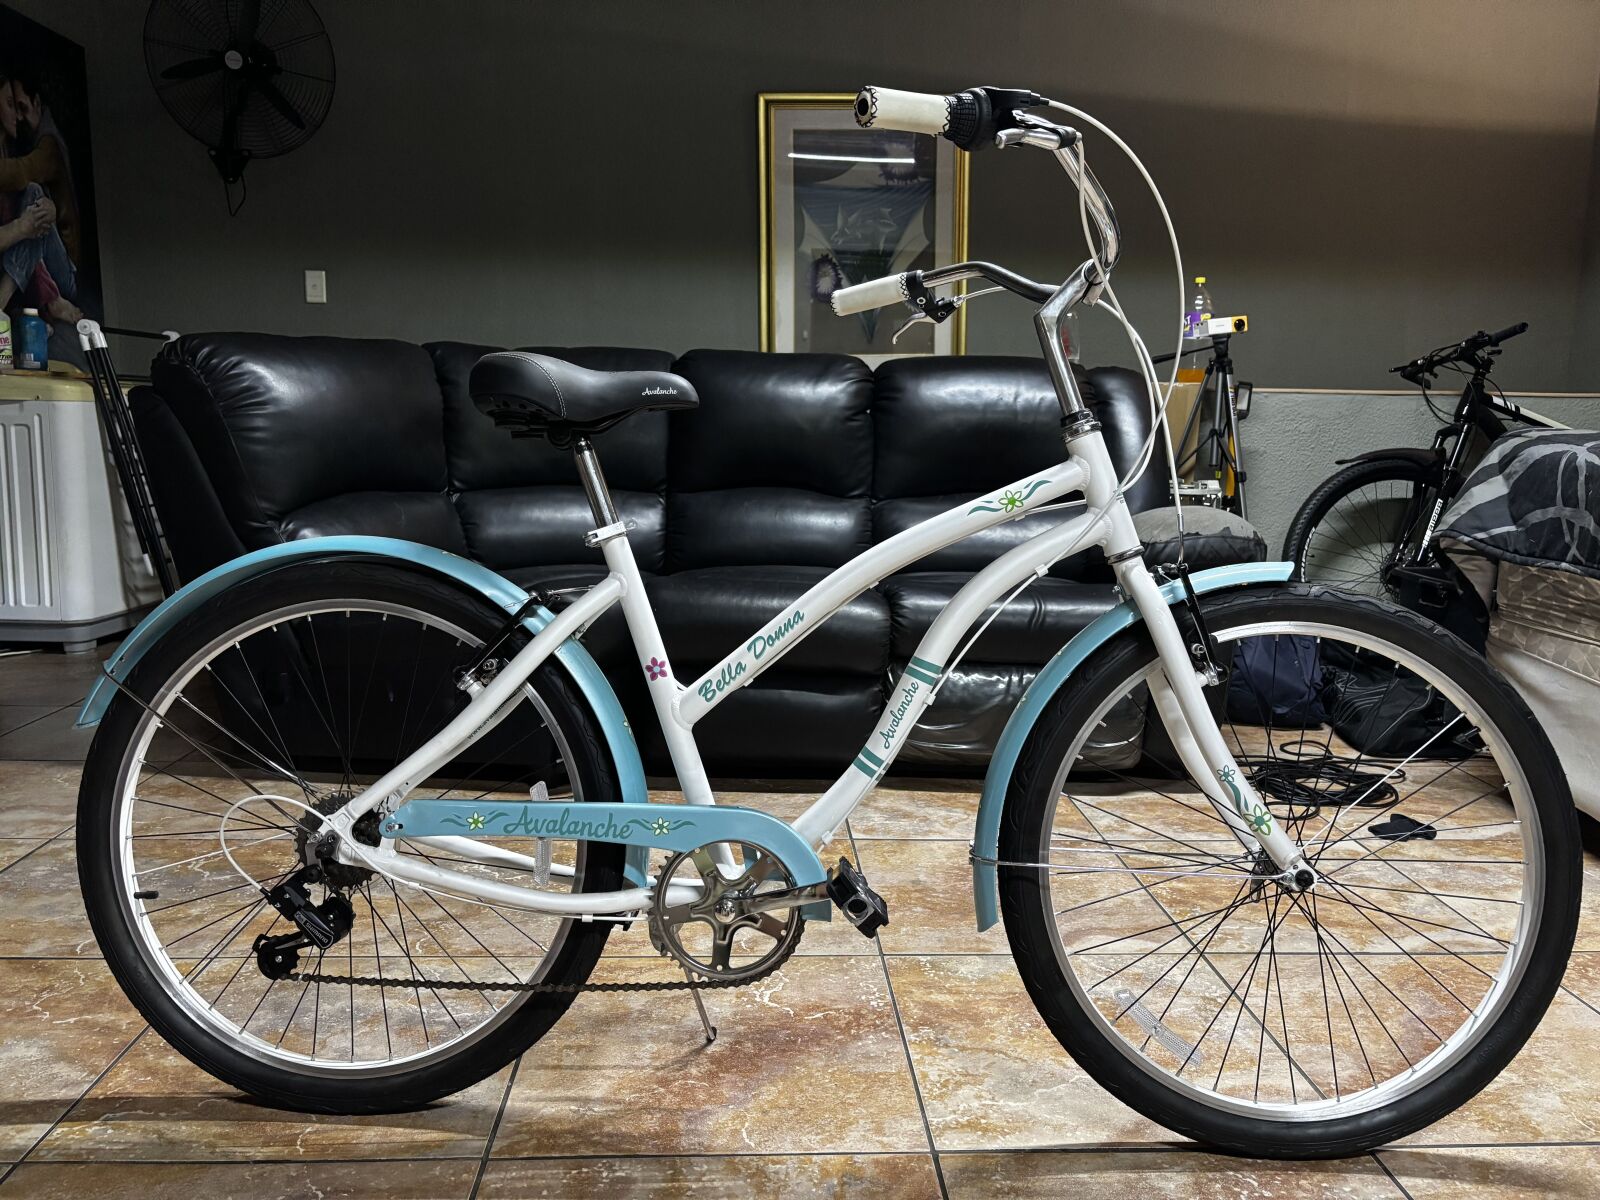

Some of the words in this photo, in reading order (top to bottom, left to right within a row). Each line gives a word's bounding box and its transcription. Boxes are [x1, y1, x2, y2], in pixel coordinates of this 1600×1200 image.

[641, 386, 678, 396] Avalanche
[698, 661, 747, 703] Bella
[746, 610, 805, 660] Donna
[879, 681, 919, 750] Avalanche
[503, 805, 633, 839] Avalanche
[305, 922, 329, 944] SHIMANO
